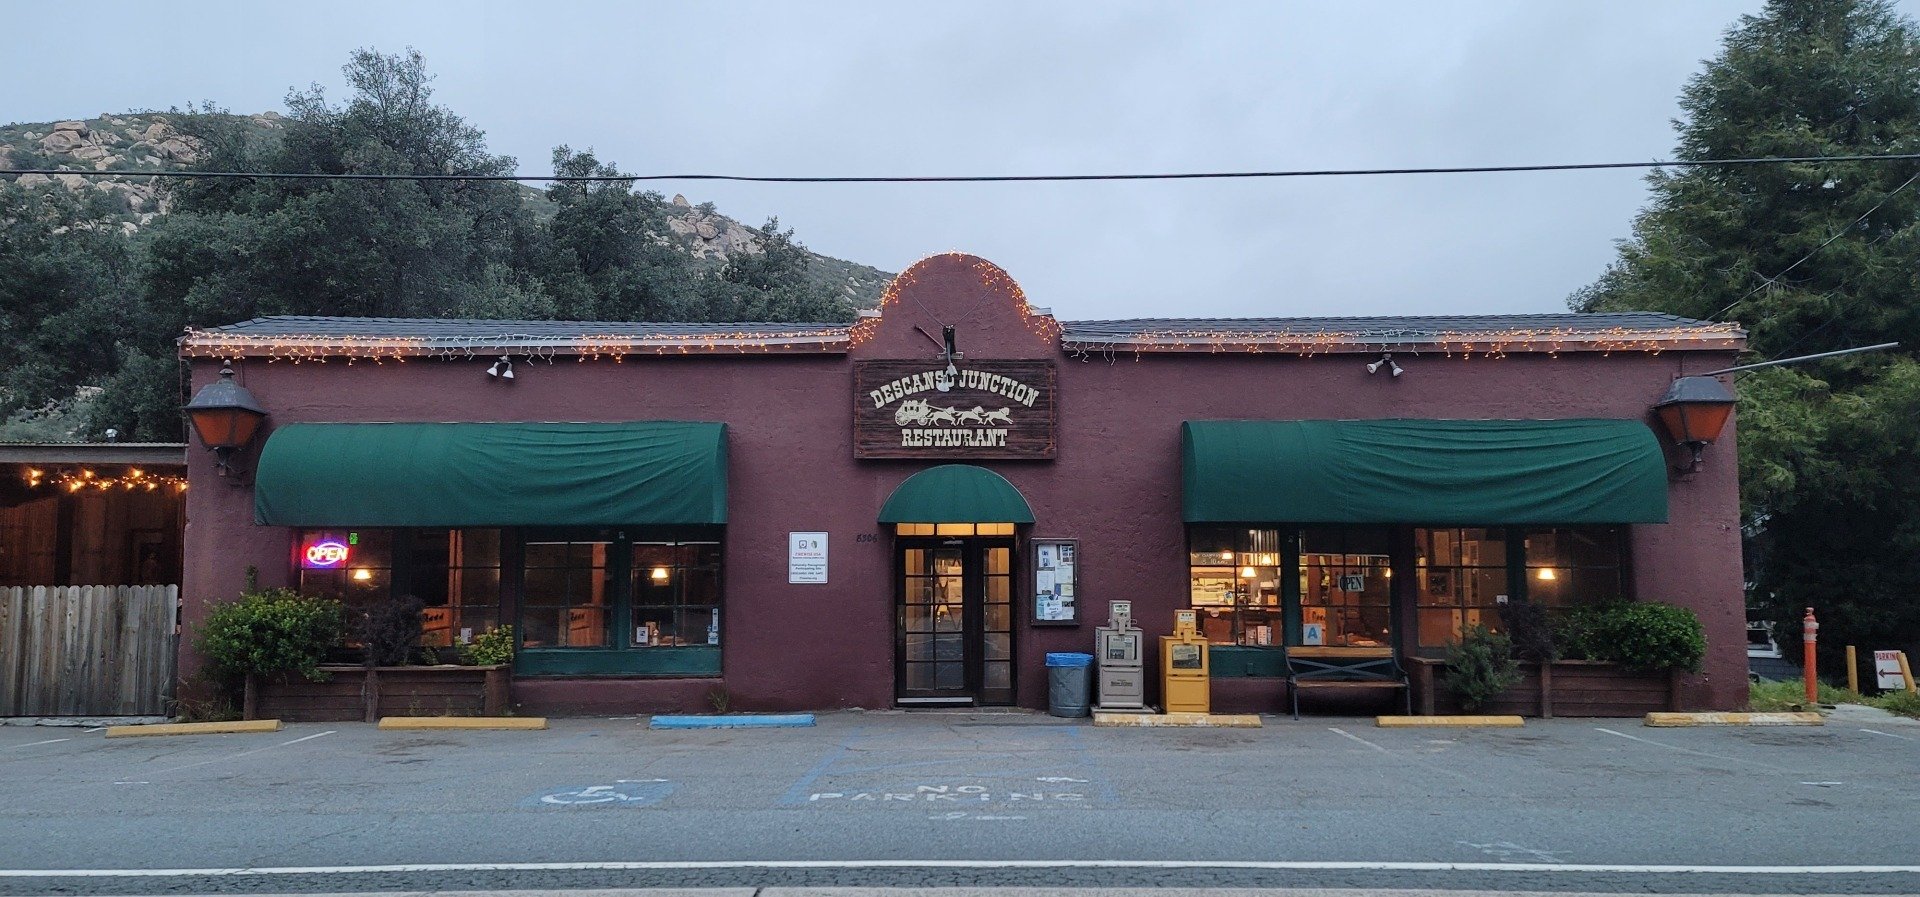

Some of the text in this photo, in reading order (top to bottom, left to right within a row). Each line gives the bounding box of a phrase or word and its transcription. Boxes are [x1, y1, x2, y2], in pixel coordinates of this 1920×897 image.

[959, 369, 1040, 408] JUNCTION
[901, 428, 1008, 447] RESTAURANT
[306, 546, 350, 562] OPEN
[1340, 576, 1362, 590] OPEN
[1307, 627, 1318, 640] A
[916, 785, 986, 794] NO
[809, 793, 1084, 801] PARKING
